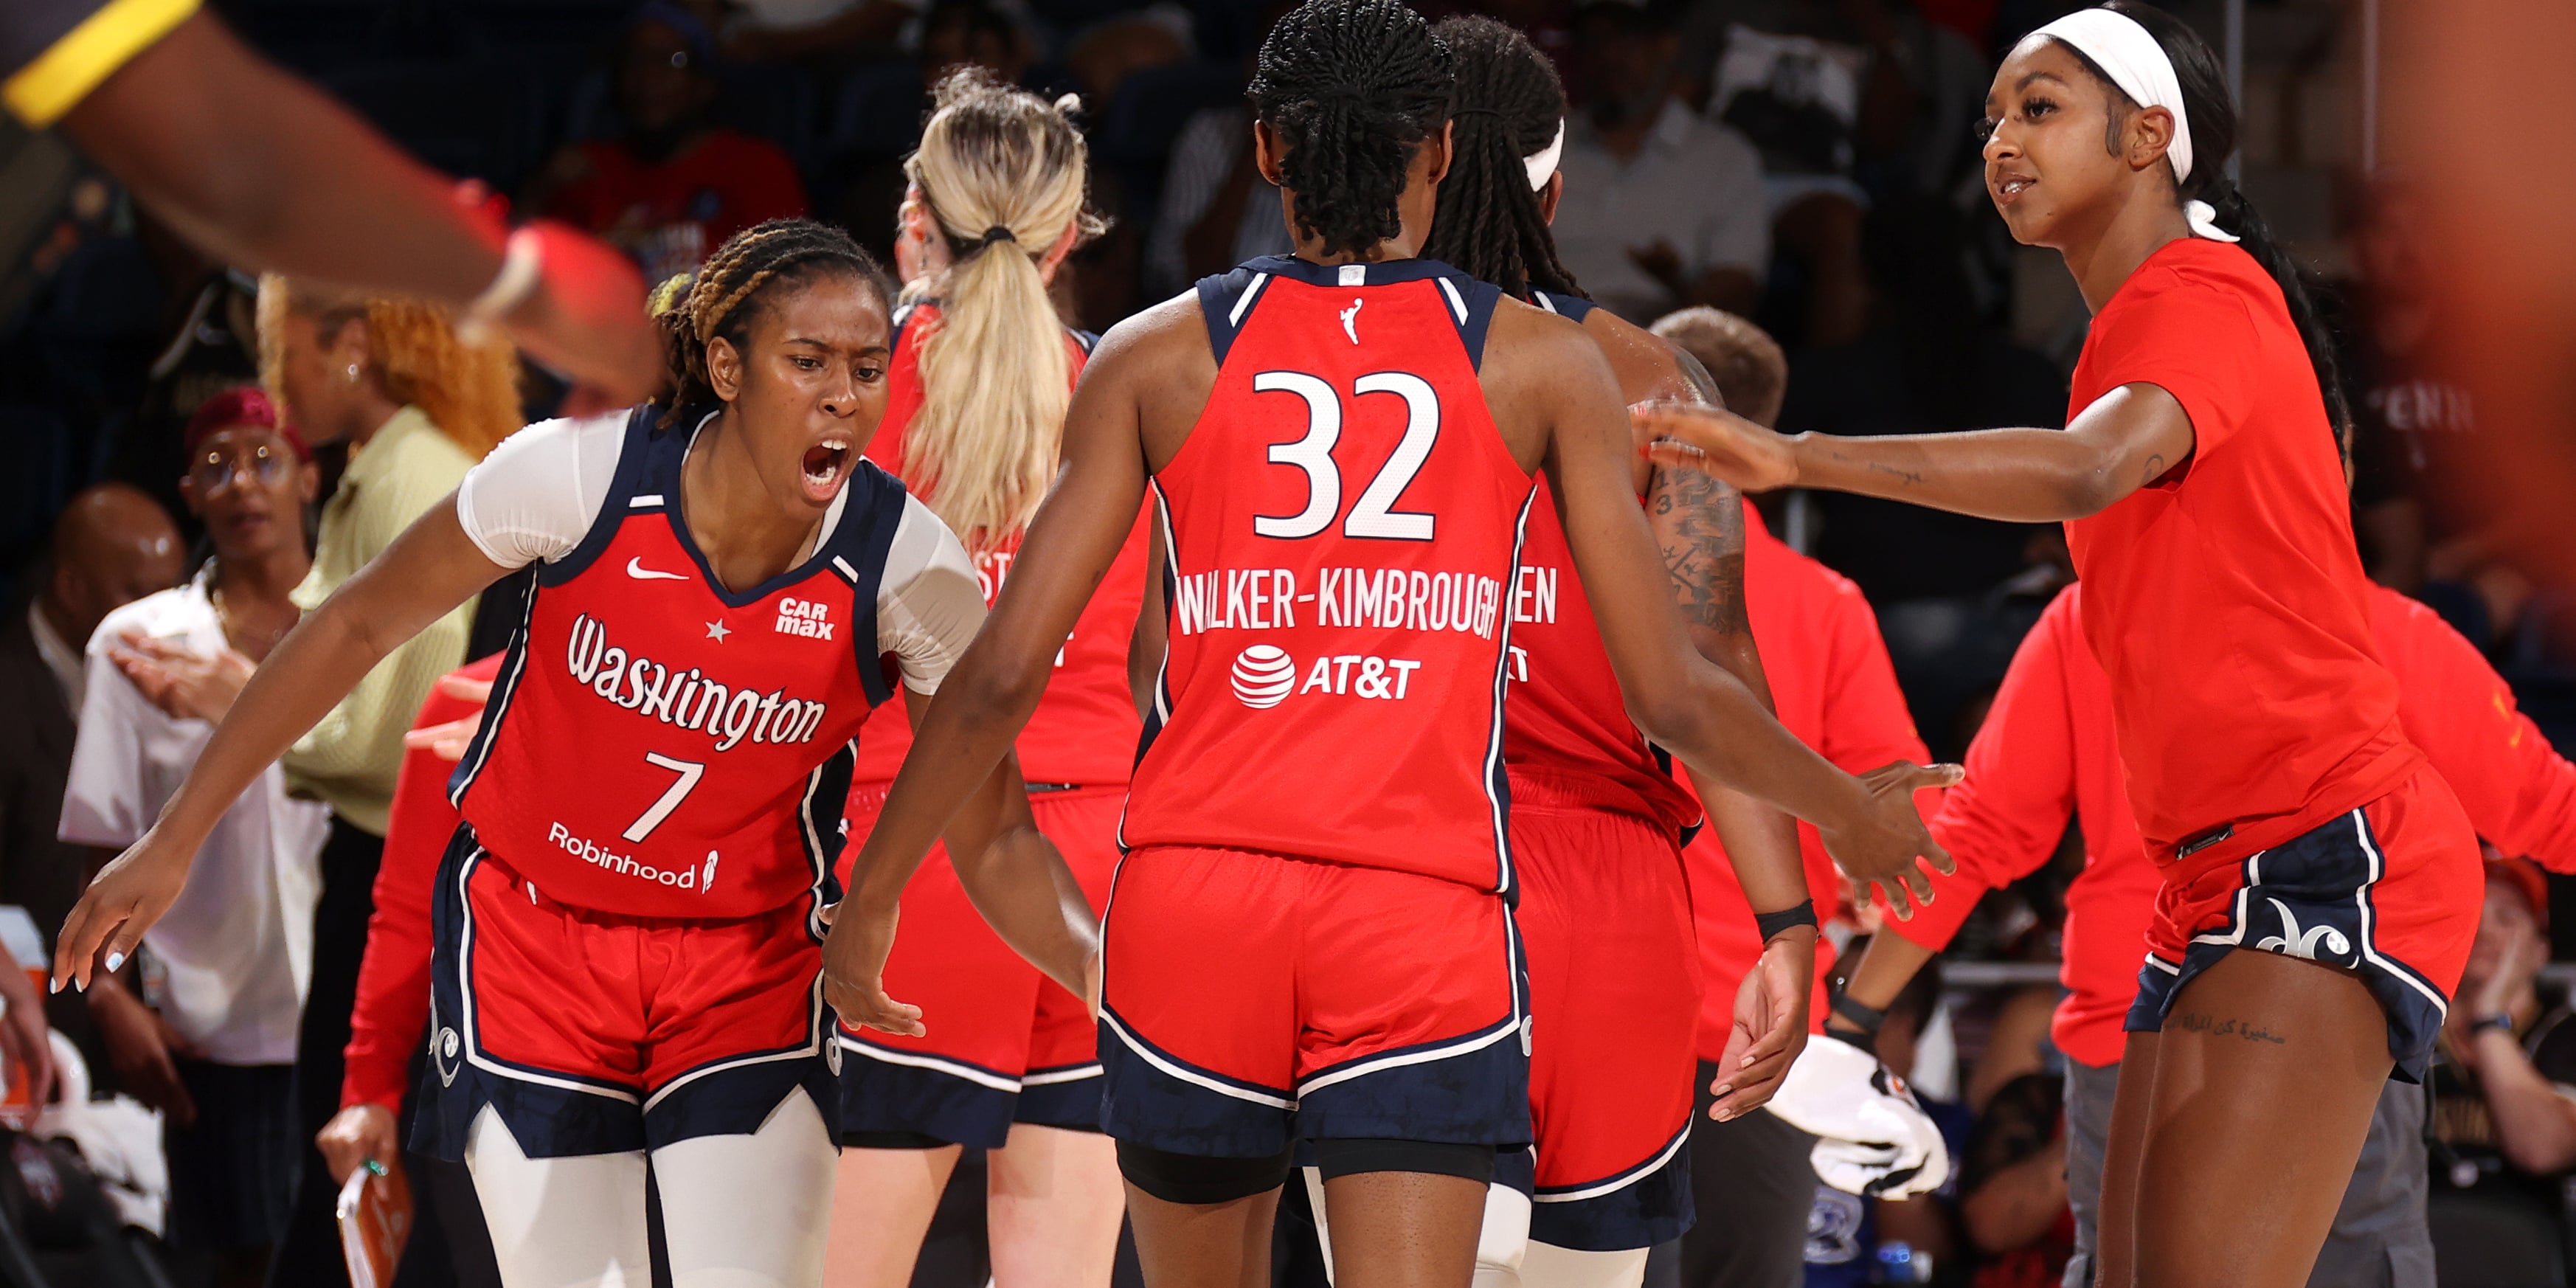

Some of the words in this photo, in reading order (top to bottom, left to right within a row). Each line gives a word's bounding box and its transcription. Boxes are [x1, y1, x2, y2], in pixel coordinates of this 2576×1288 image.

[1253, 370, 1441, 542] 32
[775, 615, 835, 640] max
[779, 597, 828, 621] CAR
[1299, 654, 1422, 700] AT&T
[621, 751, 706, 844] 7
[548, 821, 696, 889] Robinhood
